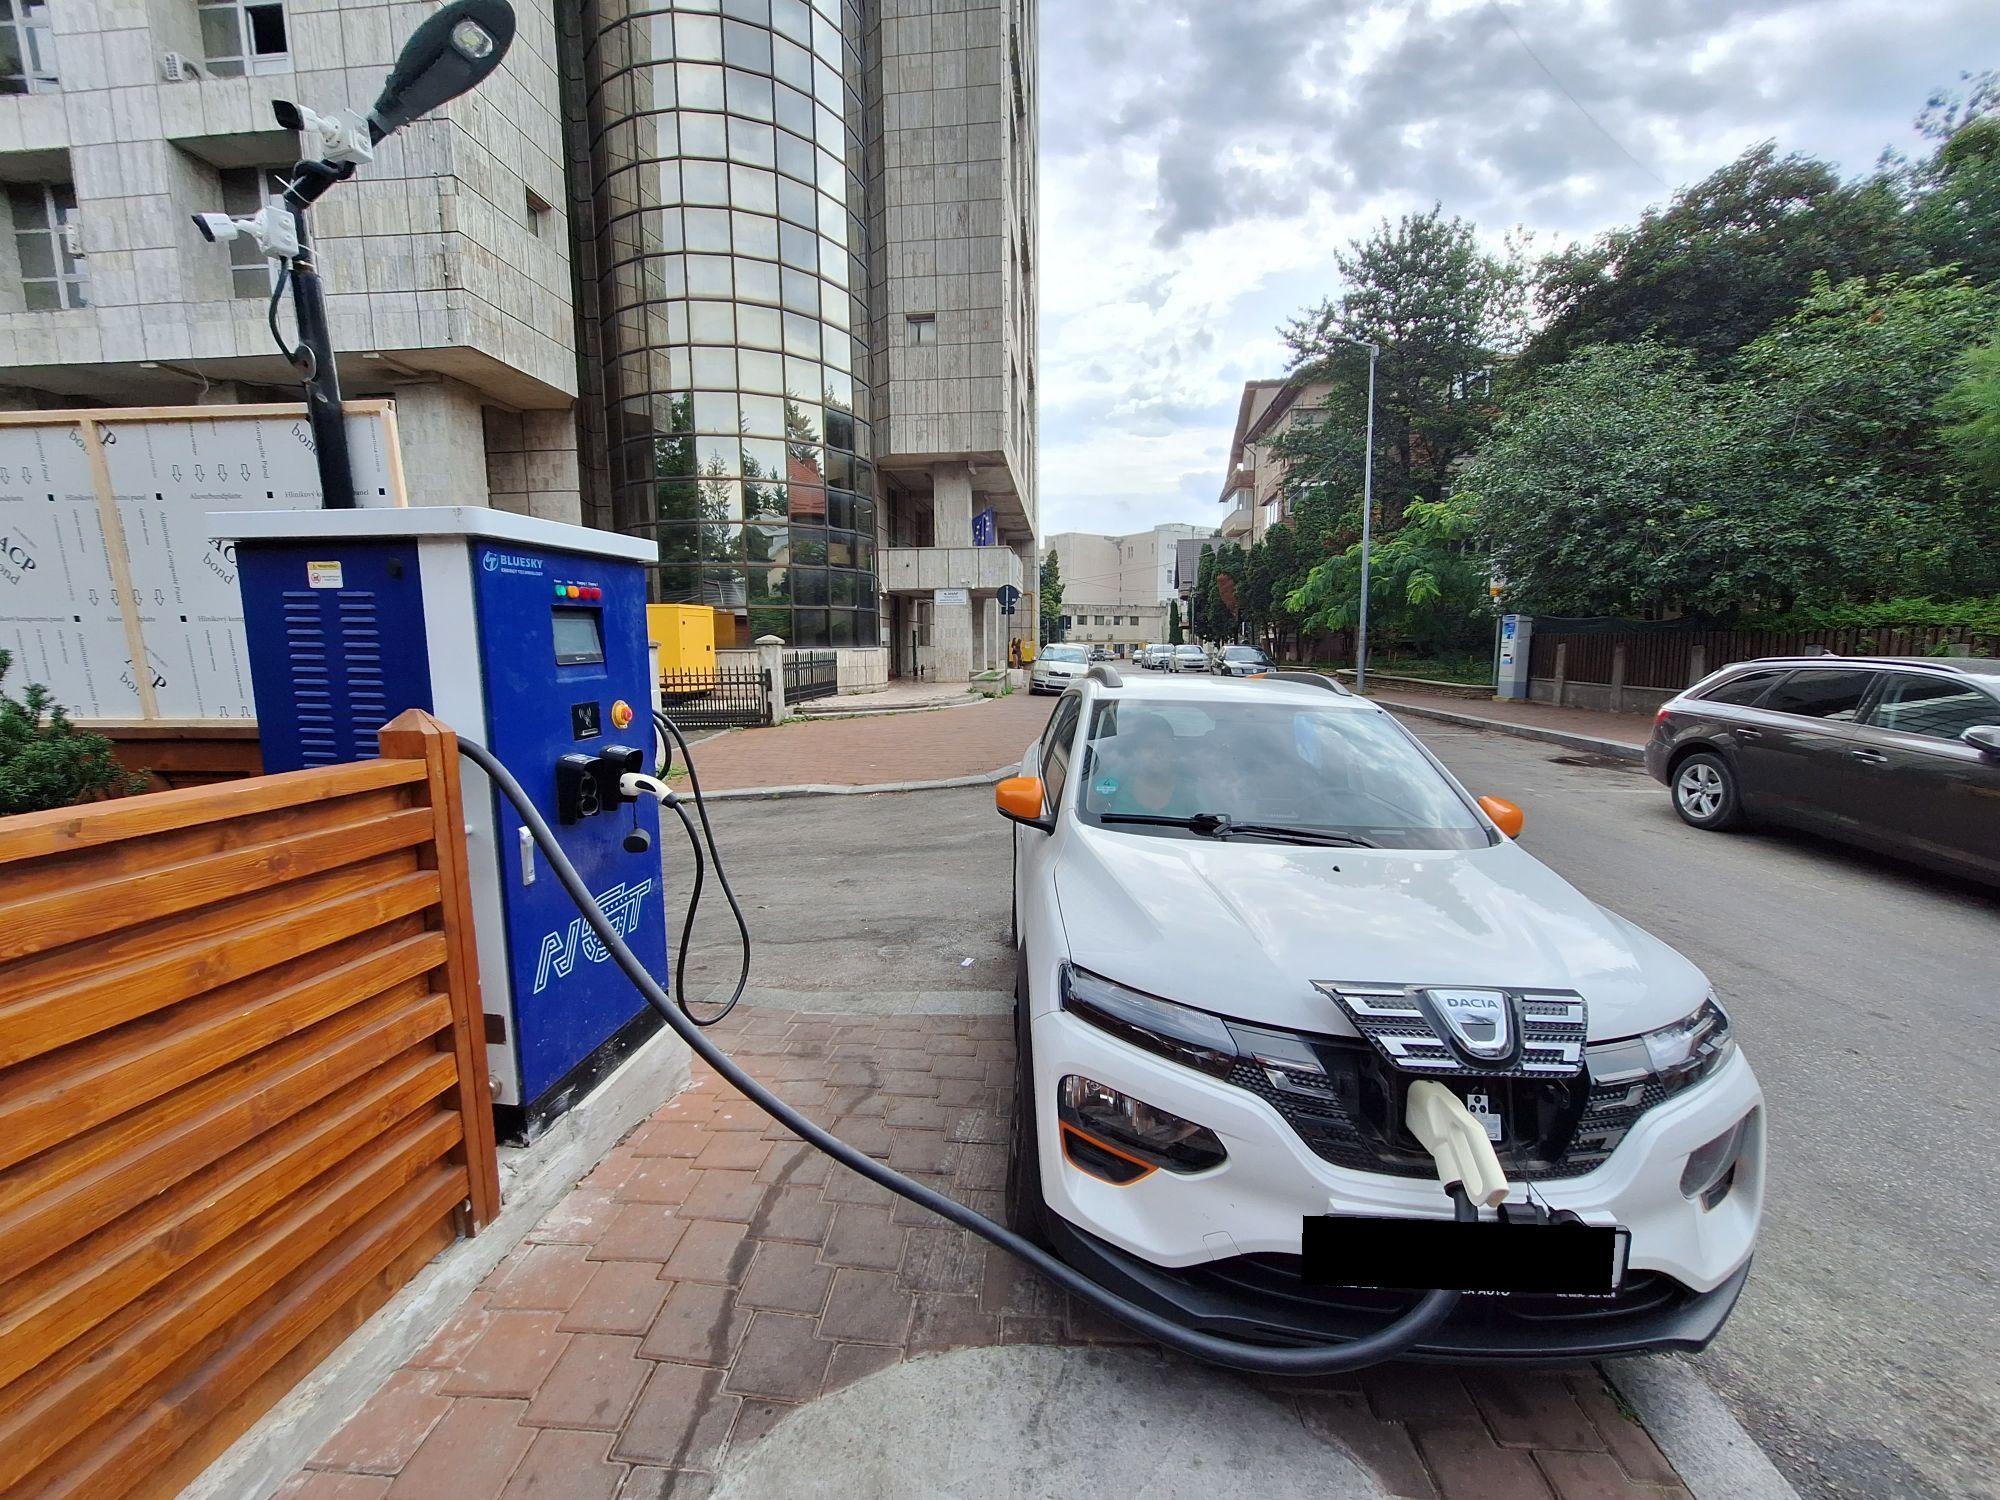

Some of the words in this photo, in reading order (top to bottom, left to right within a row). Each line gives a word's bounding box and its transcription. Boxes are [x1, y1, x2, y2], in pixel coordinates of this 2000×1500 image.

[202, 552, 235, 585] bond
[500, 554, 543, 569] BLUESKY
[1446, 998, 1498, 1009] DACIA
